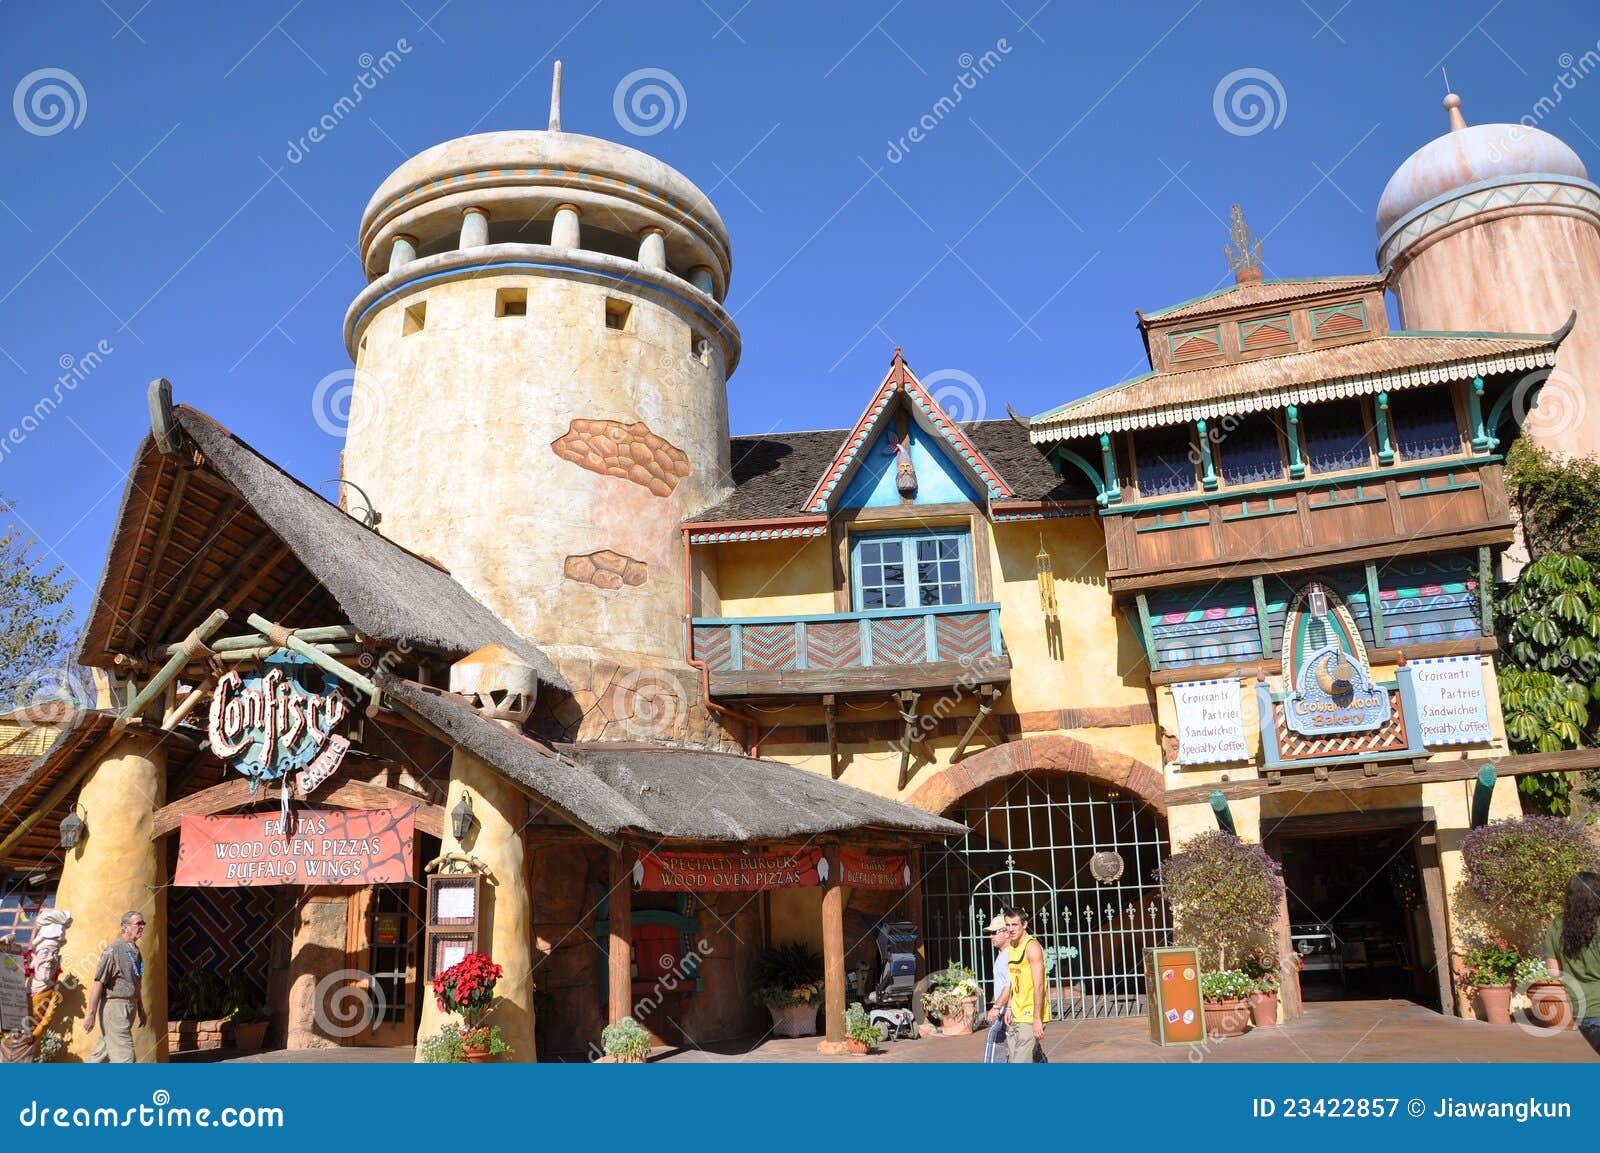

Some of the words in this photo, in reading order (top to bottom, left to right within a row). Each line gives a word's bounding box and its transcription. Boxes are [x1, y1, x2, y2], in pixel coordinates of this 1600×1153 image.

[1419, 668, 1469, 681] Croissants
[1182, 691, 1228, 704] Croissants
[1441, 688, 1480, 700] Pastries
[1202, 709, 1239, 720] Pastries
[1423, 704, 1478, 717] Sandwiches
[1312, 713, 1365, 726] Bakery
[1185, 725, 1237, 737] Sandwiches
[1420, 723, 1456, 737] Specialty
[1459, 720, 1487, 732] Coffee
[1182, 741, 1216, 757] Specialty
[301, 741, 347, 792] GRILLE
[215, 841, 263, 859] WOOD
[269, 839, 315, 856] OVEN
[322, 838, 380, 856] PIZZAS
[226, 860, 297, 879] BUFFALO
[305, 860, 361, 877] WINGS
[662, 857, 733, 871] SPECIALTY
[739, 856, 799, 870] BURGERS
[661, 873, 707, 886] WOOD
[712, 873, 751, 886] OVEN
[755, 870, 801, 885] PIZZAS
